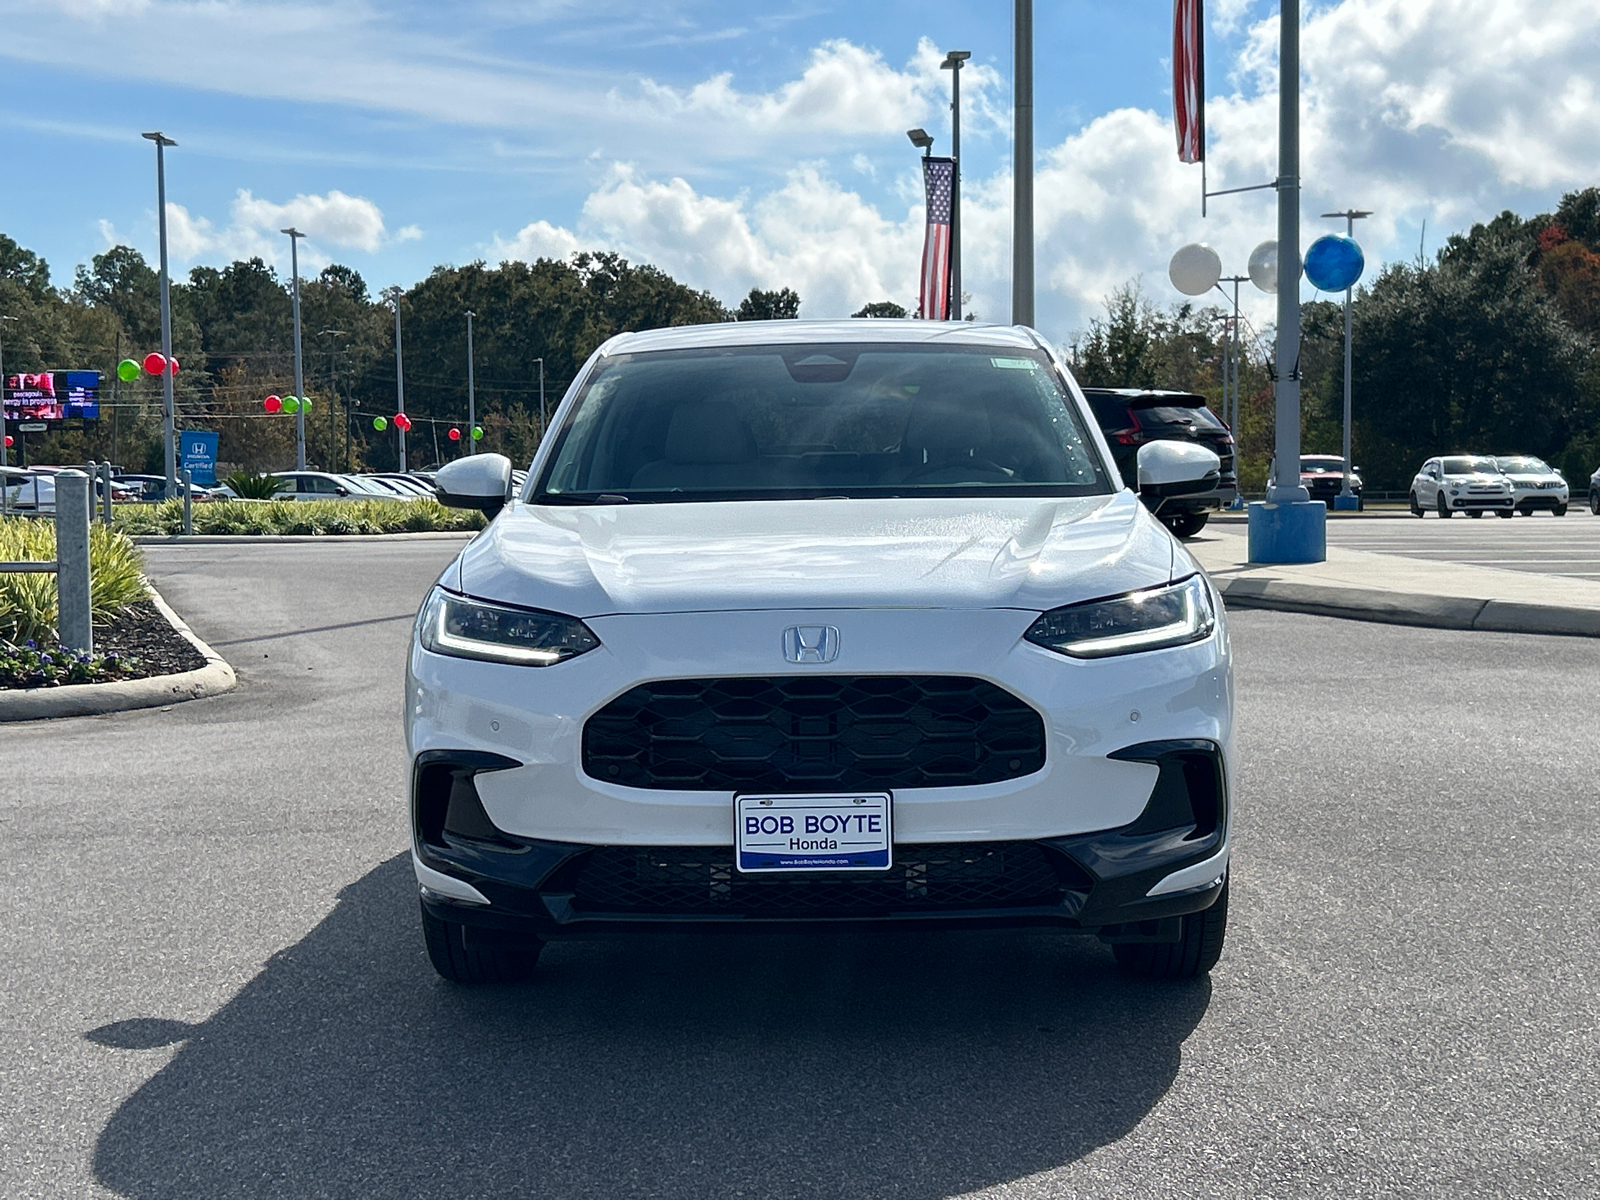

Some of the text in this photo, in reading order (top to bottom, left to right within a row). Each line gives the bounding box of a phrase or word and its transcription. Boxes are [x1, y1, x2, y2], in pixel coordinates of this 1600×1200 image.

[3, 397, 58, 407] nergy in progress
[183, 461, 213, 469] Certified
[745, 814, 882, 835] BOB BOYTE
[789, 837, 838, 850] Honda
[779, 858, 849, 866] www.BobBoyteHonda.com
